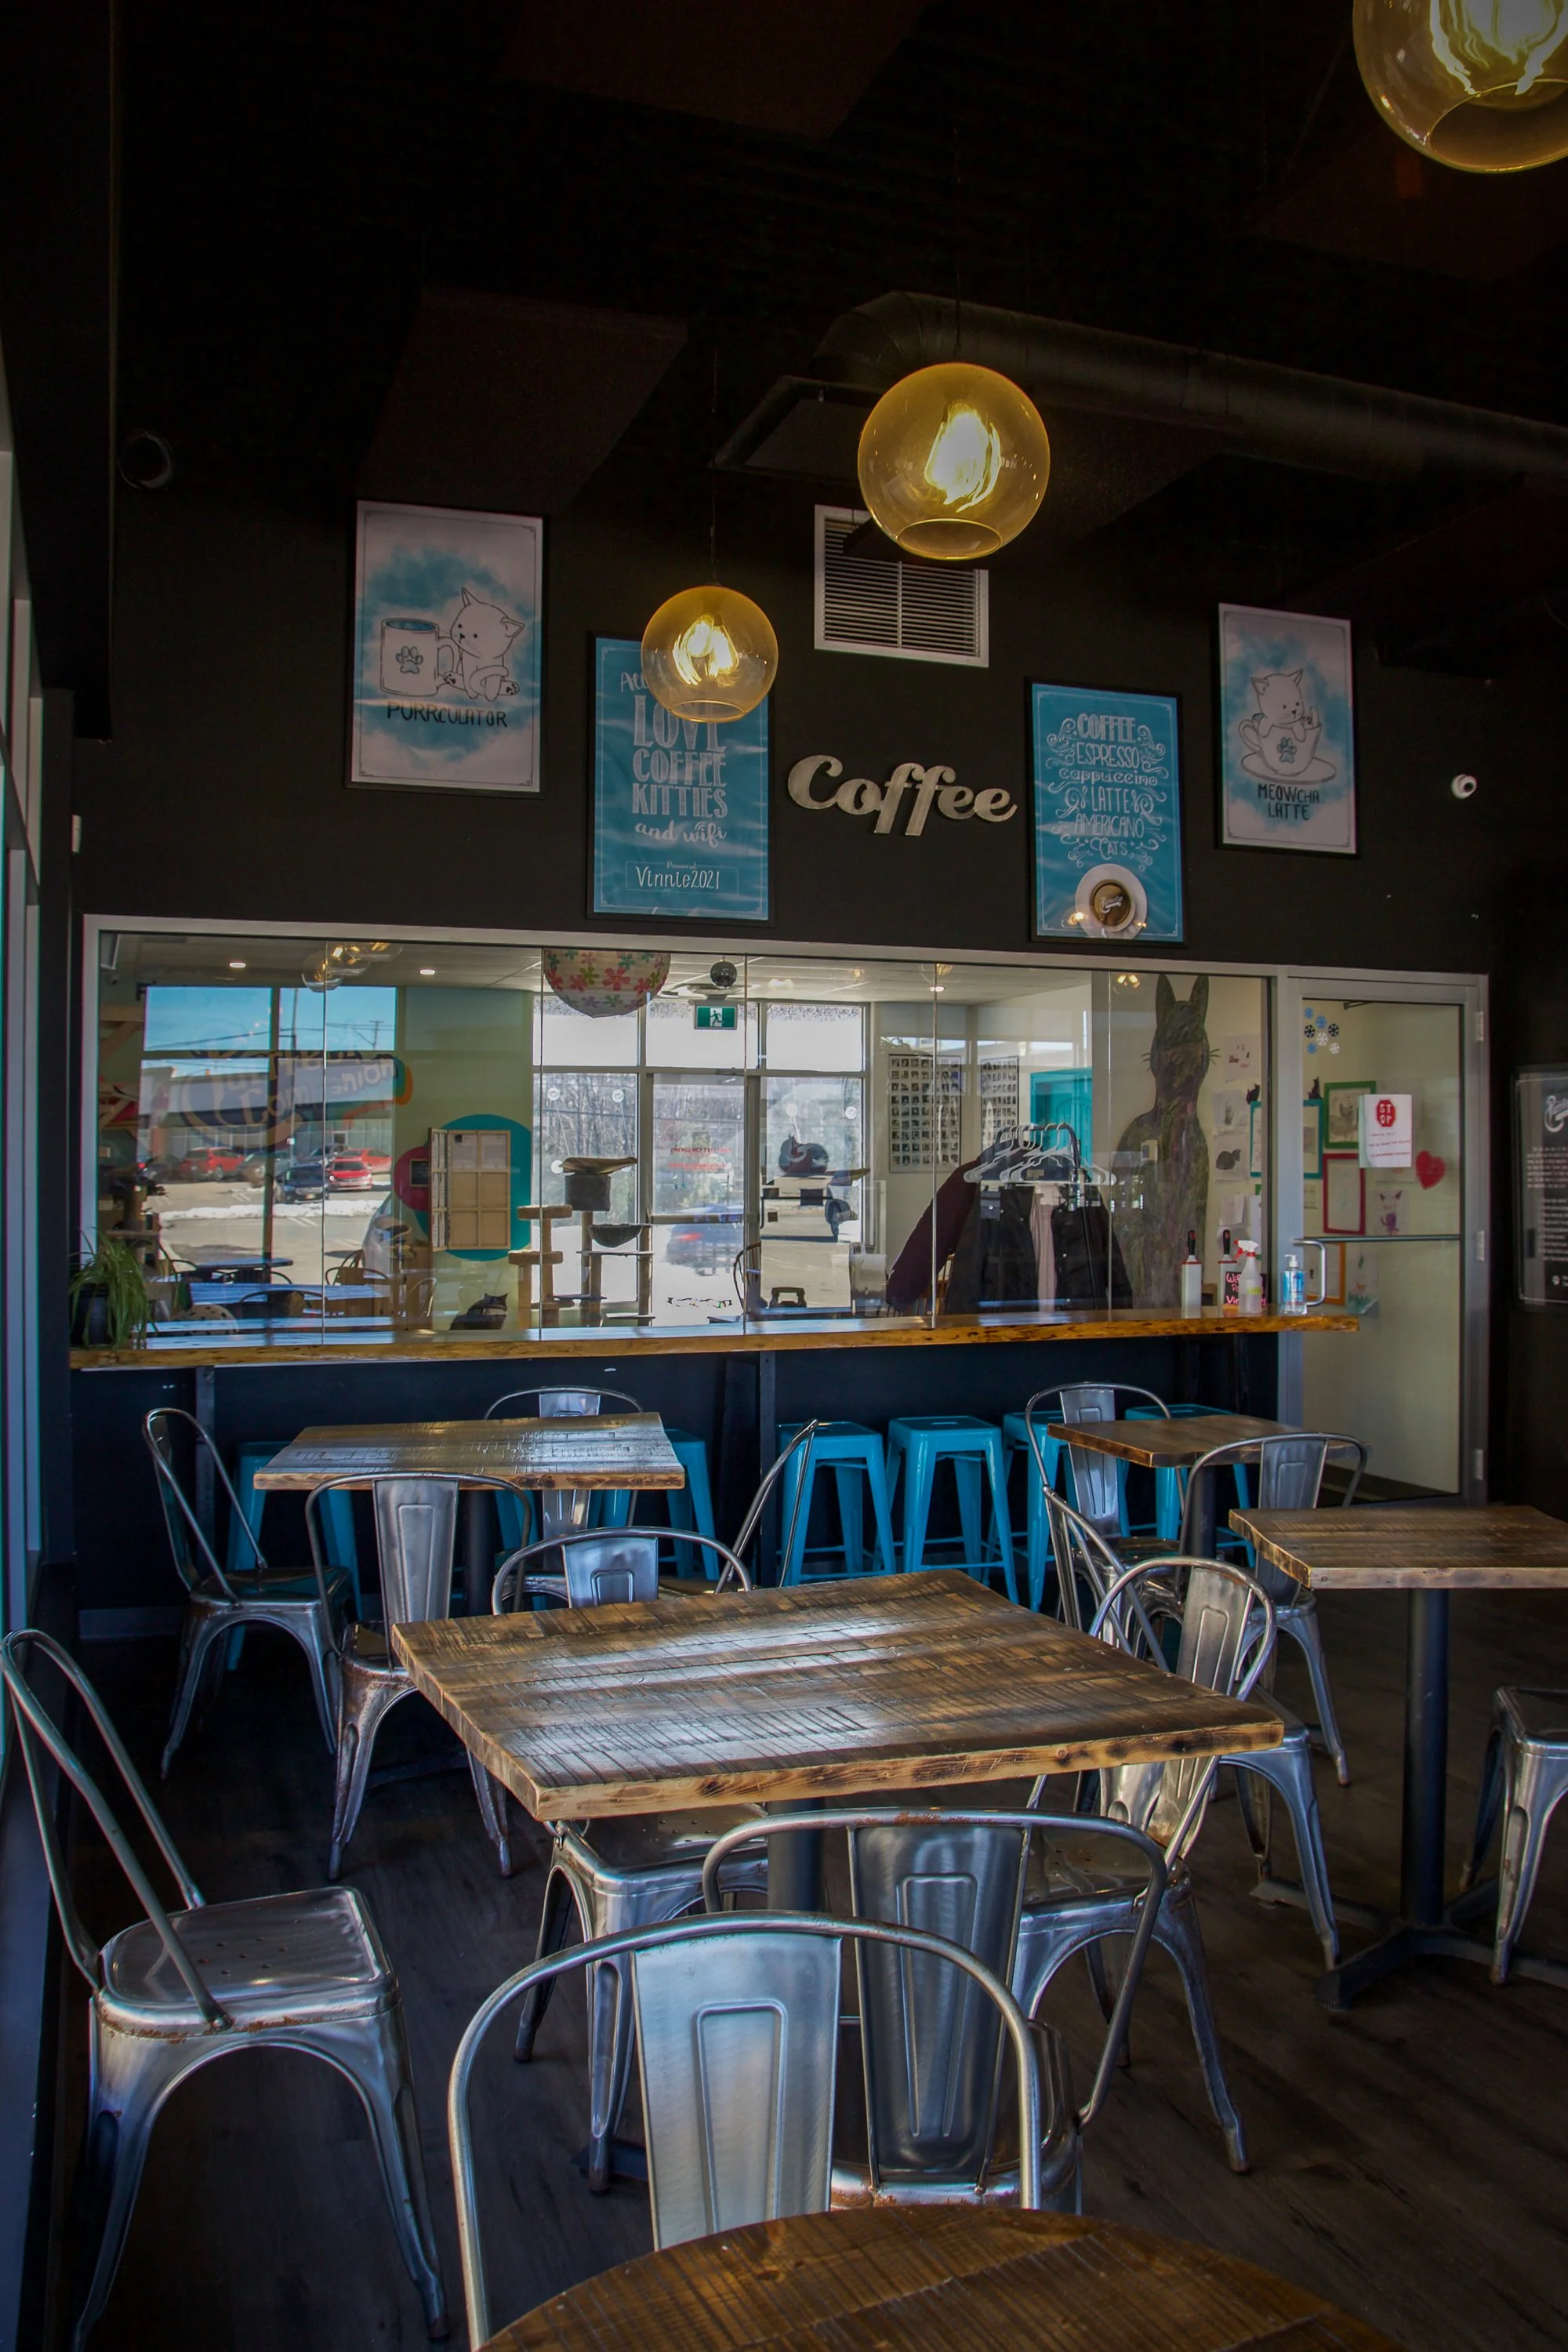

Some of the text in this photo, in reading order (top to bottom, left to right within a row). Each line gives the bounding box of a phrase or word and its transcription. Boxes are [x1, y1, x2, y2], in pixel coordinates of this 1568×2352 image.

[387, 701, 508, 728] PURRCULATOR
[1076, 713, 1137, 743] COFFEE
[633, 748, 727, 787] COFFEE
[1076, 742, 1139, 768] ESPRESSO
[1058, 768, 1158, 786] cappuccino
[632, 783, 728, 818] KITTIES
[788, 754, 1018, 837] Coffee
[1091, 785, 1131, 814] LATTE
[1258, 783, 1319, 804] MEOWCHA
[1268, 801, 1309, 821] LATTE
[635, 819, 727, 848] and wifi
[1073, 812, 1145, 838] AMERICANO
[636, 866, 720, 890] Vinnie2021
